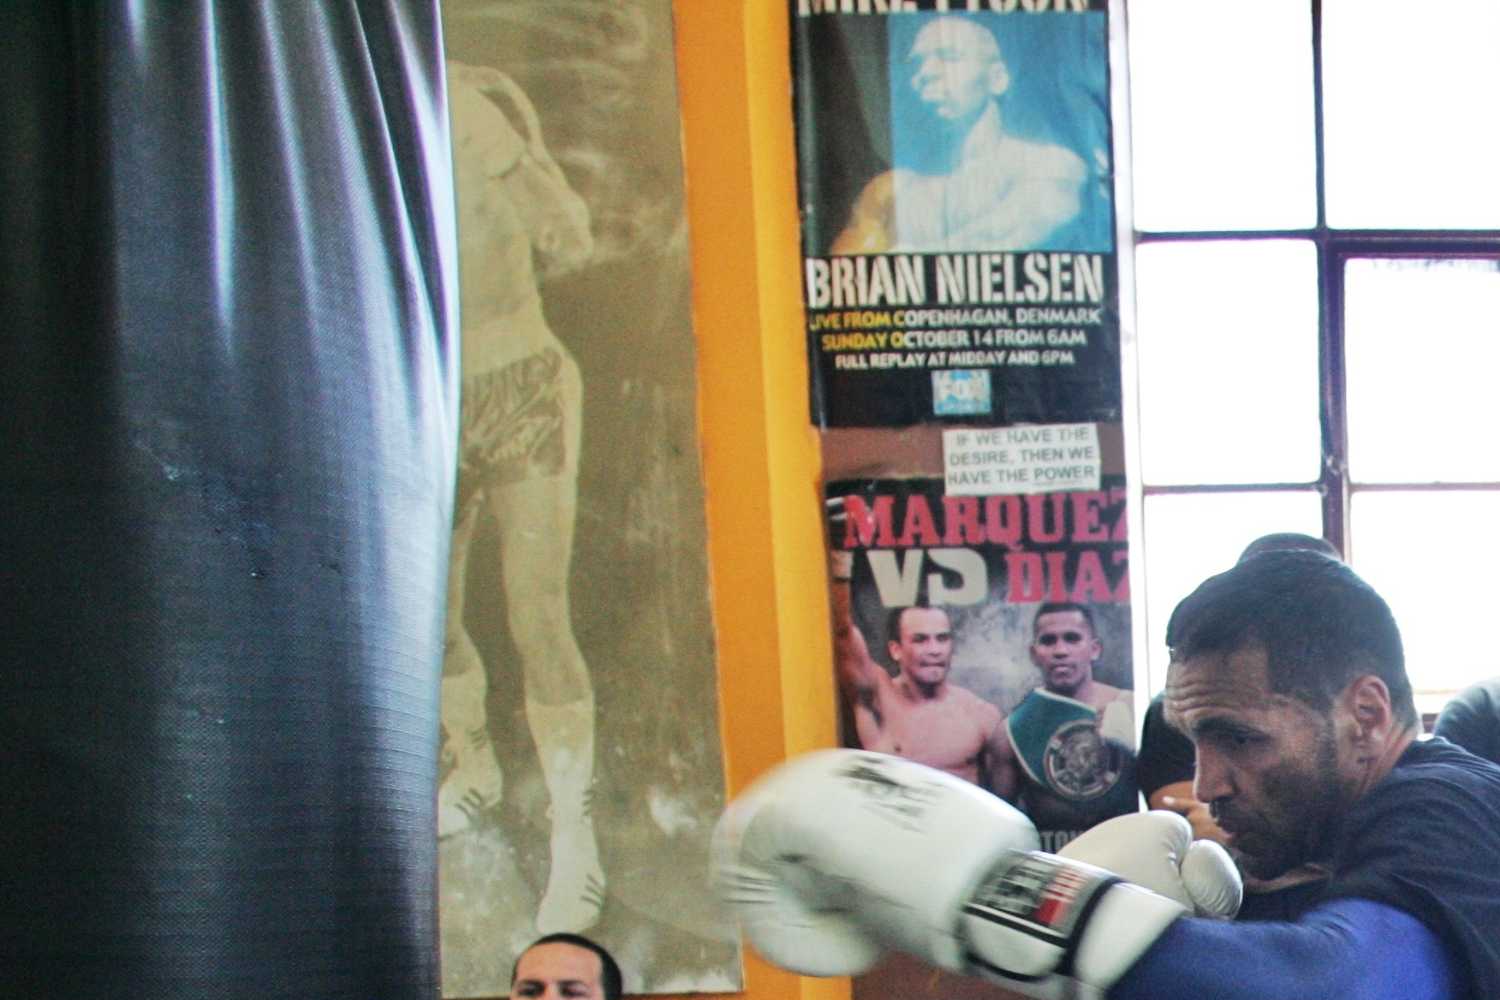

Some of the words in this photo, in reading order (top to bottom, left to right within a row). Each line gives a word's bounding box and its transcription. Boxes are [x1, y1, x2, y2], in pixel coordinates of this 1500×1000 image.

[806, 254, 926, 308] BRIAN
[935, 252, 1104, 304] NIELSEN
[841, 311, 892, 328] FROM
[893, 308, 1013, 326] COPENHAGAN,
[1016, 307, 1101, 324] DENMARK
[822, 333, 886, 350] SUNDAY
[892, 330, 969, 348] OCTOBER
[973, 330, 993, 346] 14
[995, 329, 1045, 346] FROM
[1047, 328, 1086, 345] 6AM
[836, 353, 868, 369] FULL
[870, 352, 924, 368] REPLAY
[927, 351, 947, 366] AT
[948, 350, 1007, 366] MIDDAY
[1007, 349, 1038, 365] AND
[955, 432, 969, 447] IF
[975, 429, 999, 445] WE
[1006, 427, 1051, 443] HAVE
[1058, 425, 1090, 441] THE
[949, 450, 1014, 467] DESIRE,
[1020, 449, 1063, 464] THEN
[1068, 446, 1094, 461] WE
[948, 469, 992, 486] HAVE
[998, 467, 1030, 482] THE
[1033, 465, 1094, 481] POWER
[867, 549, 988, 608] VS
